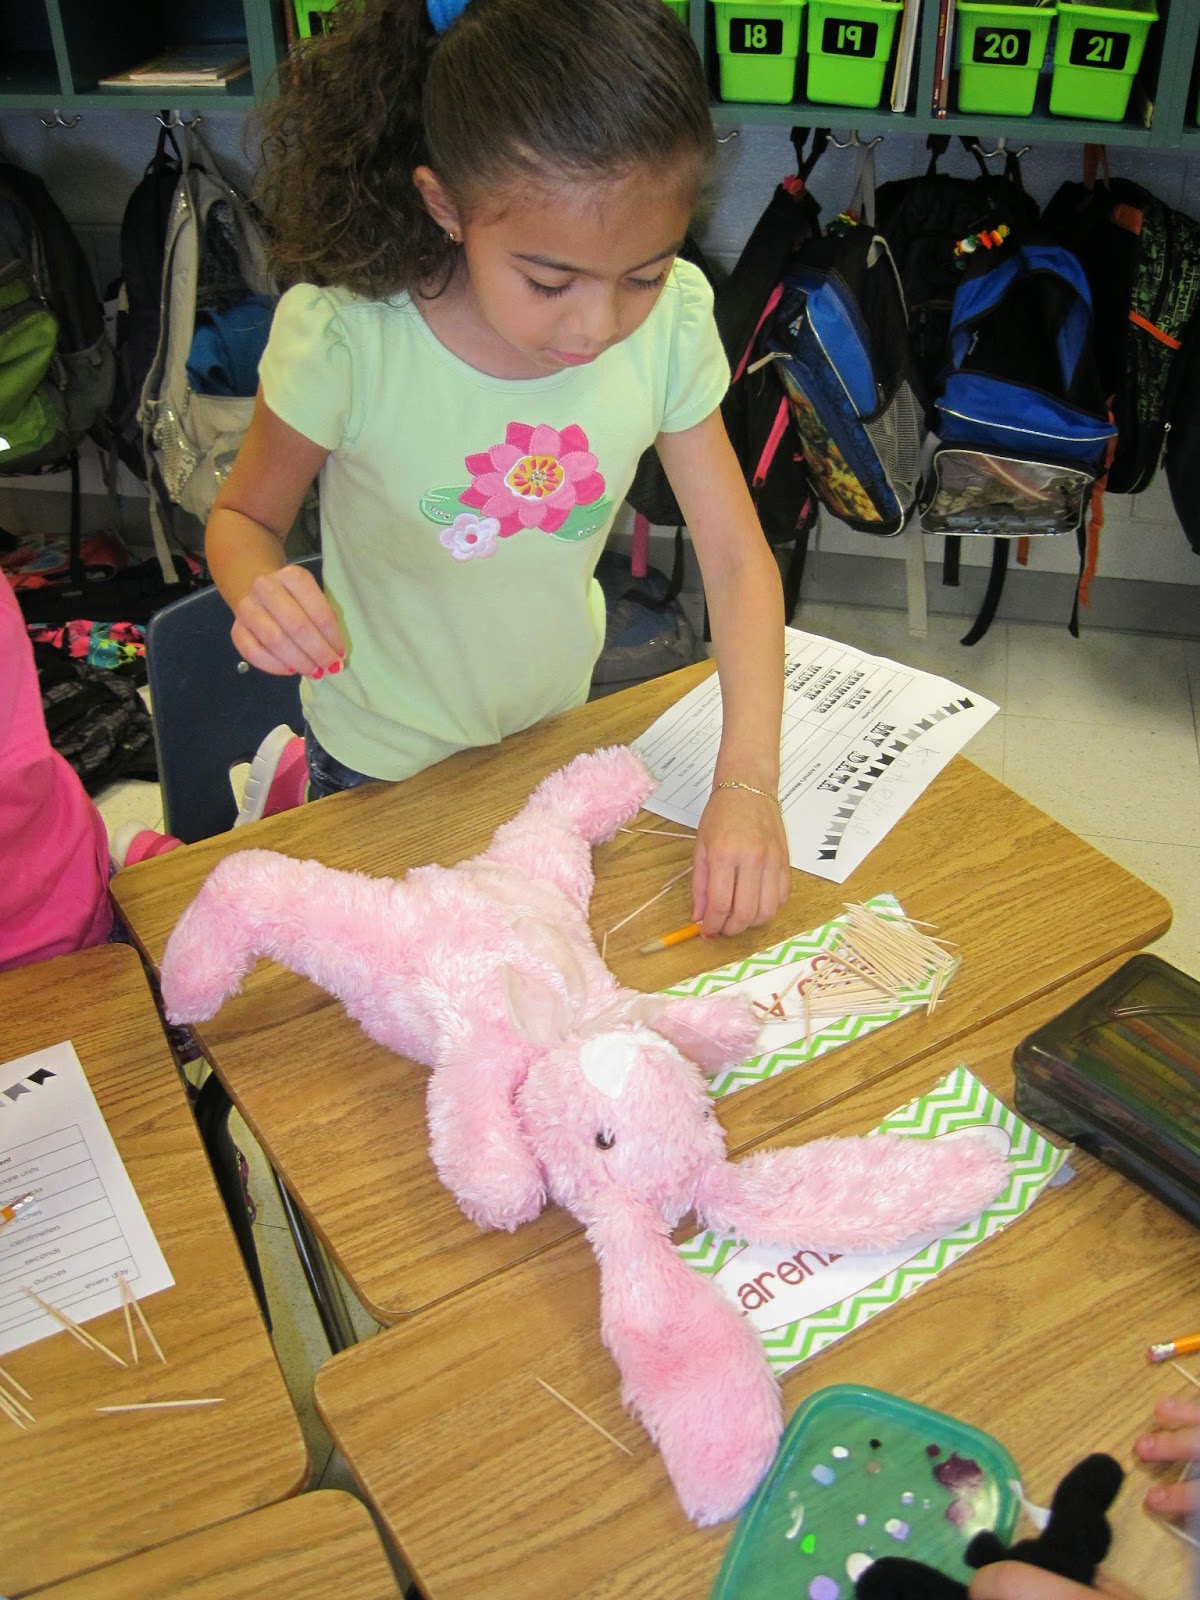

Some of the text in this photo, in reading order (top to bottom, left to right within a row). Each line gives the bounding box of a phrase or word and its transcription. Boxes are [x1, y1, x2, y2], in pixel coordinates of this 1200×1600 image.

[744, 24, 768, 49] 18
[837, 26, 862, 52] 19
[983, 34, 1019, 60] 20
[1086, 37, 1114, 63] 21
[784, 663, 801, 680] TIM
[787, 665, 823, 692] WIDTH
[803, 668, 842, 701] LENGTH
[813, 669, 866, 714] PERIMETER
[843, 687, 872, 710] AREA
[816, 721, 897, 793] MY DATA
[9, 1224, 61, 1248] centimeters
[33, 1268, 67, 1286] ounces
[84, 1276, 109, 1290] every
[738, 1250, 844, 1317] aren
